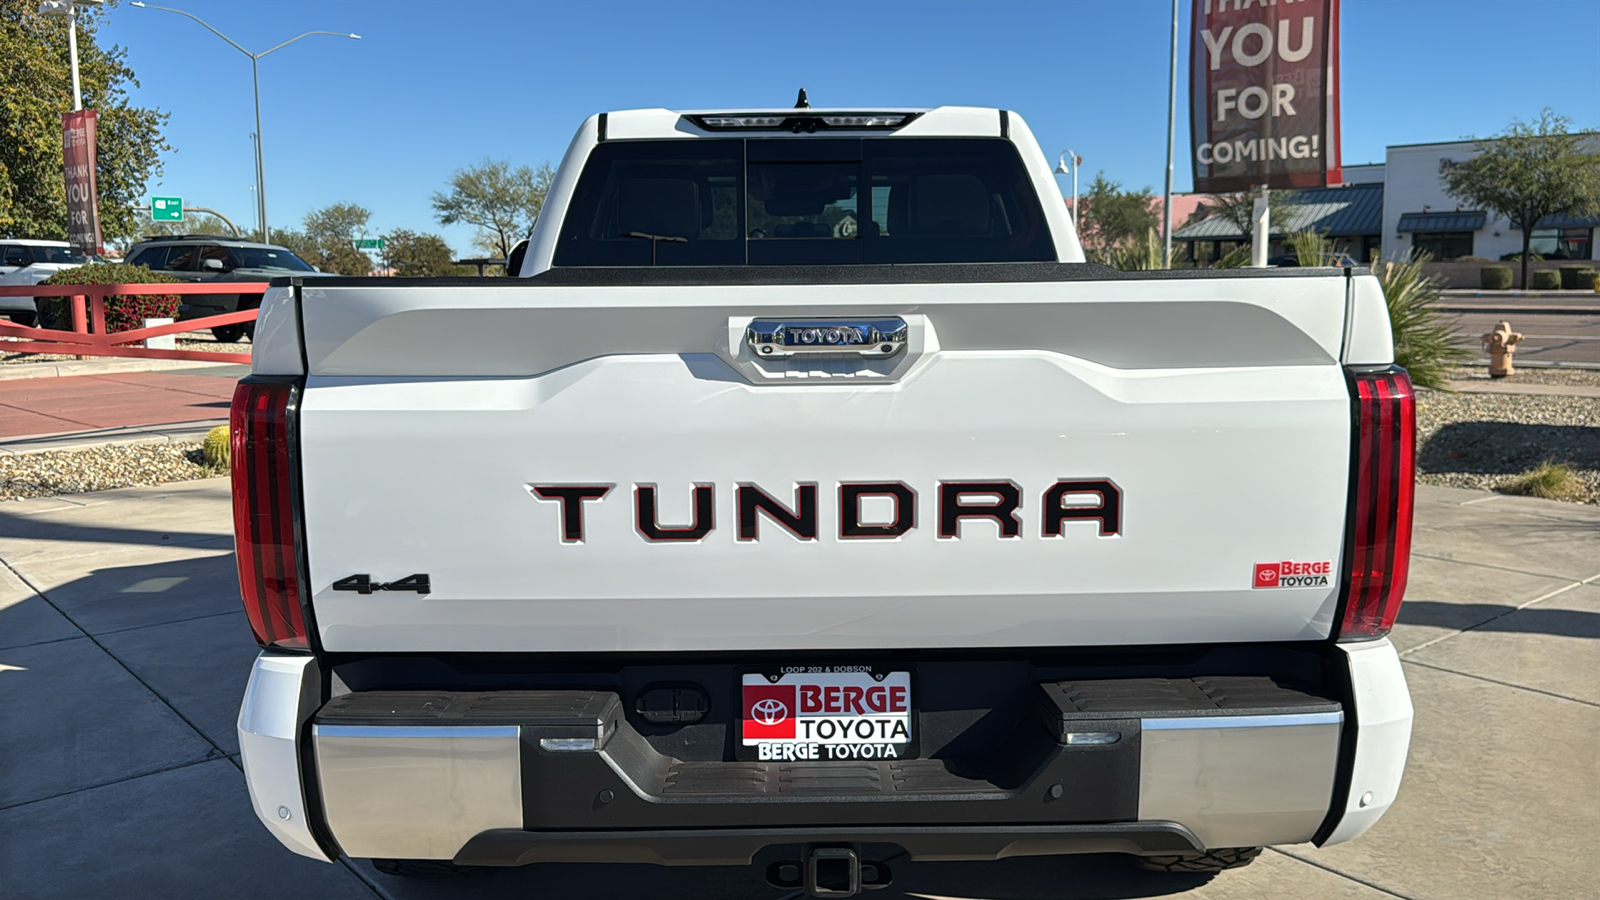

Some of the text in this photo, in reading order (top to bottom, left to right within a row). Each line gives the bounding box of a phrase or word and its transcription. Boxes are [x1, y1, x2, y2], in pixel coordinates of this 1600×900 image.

[1200, 16, 1315, 71] YOU
[1216, 83, 1297, 122] FOR
[1196, 134, 1320, 165] COMING!
[65, 164, 88, 178] THANK
[67, 183, 89, 203] YOU
[71, 210, 88, 225] FOR
[790, 328, 864, 344] TOYOTA
[525, 477, 1124, 545] TUNDRA
[1280, 561, 1331, 575] BERGE
[1280, 576, 1328, 586] TOYOTA
[833, 665, 872, 673] DOBSON
[799, 685, 908, 716] BERGE
[800, 719, 910, 740] TOYOTA
[758, 742, 898, 762] BERGE TOYOTA
